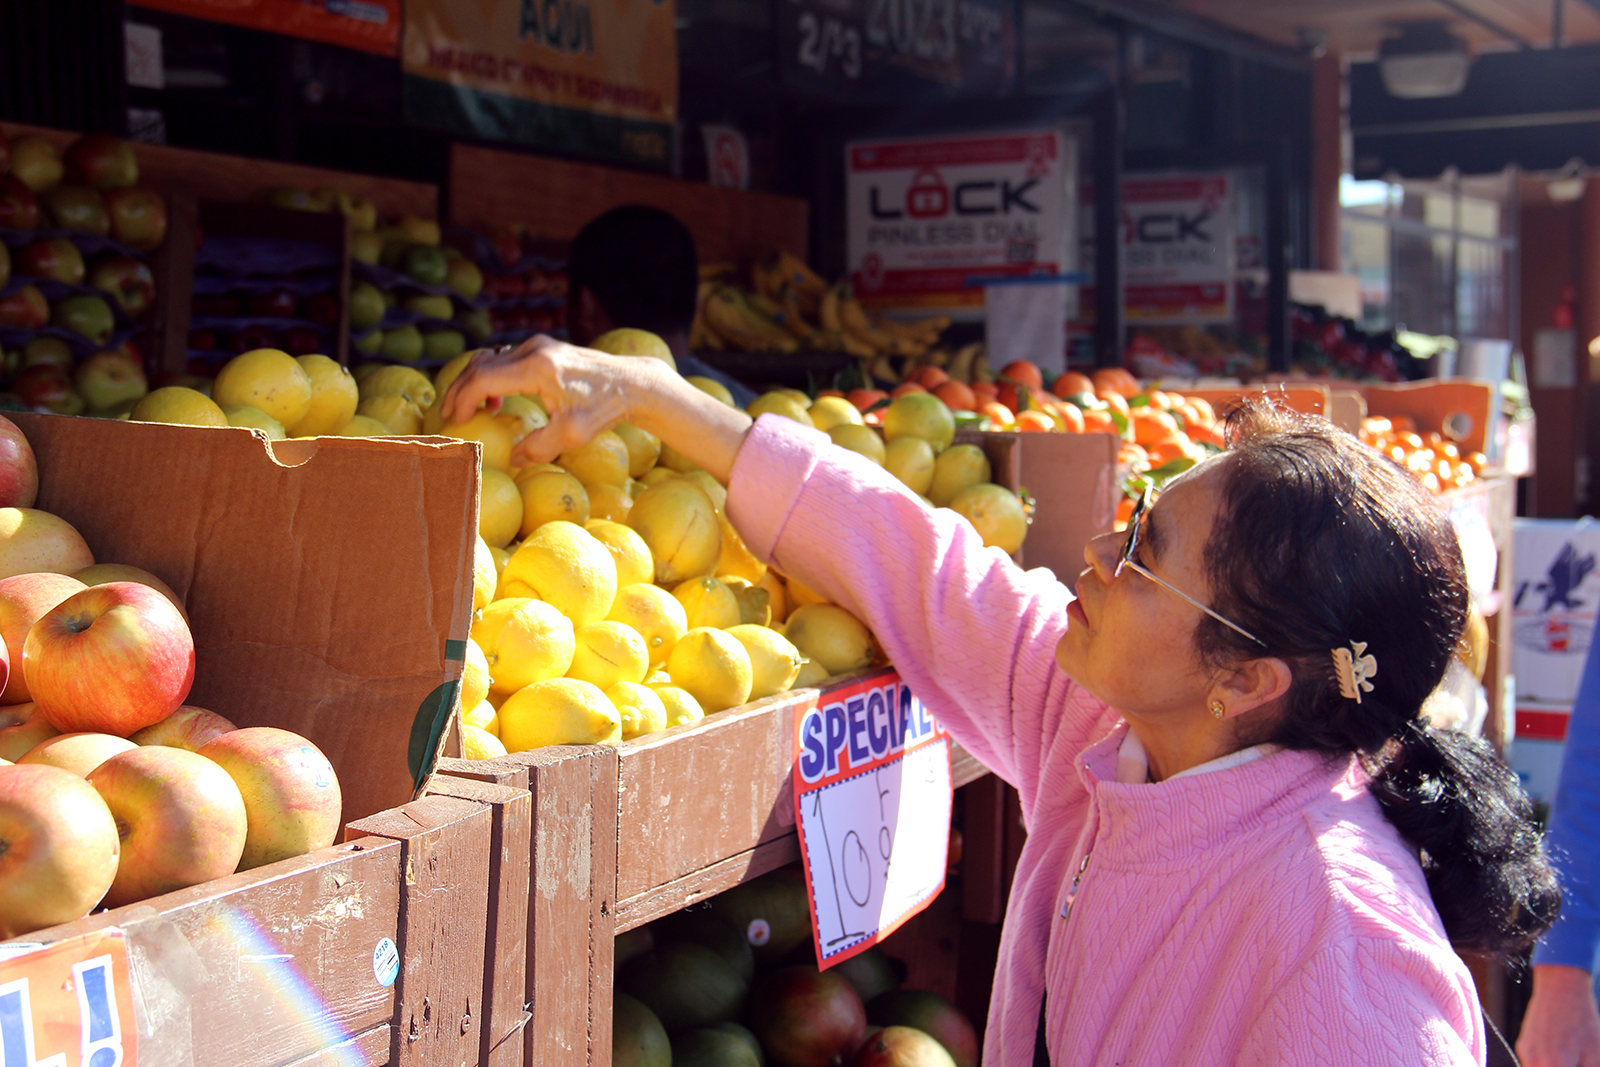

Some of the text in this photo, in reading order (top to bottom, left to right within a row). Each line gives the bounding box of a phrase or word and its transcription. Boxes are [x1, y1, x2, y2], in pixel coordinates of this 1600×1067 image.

[518, 0, 594, 57] AQUI
[869, 170, 1041, 221] LOCK
[867, 221, 976, 246] PINLESS
